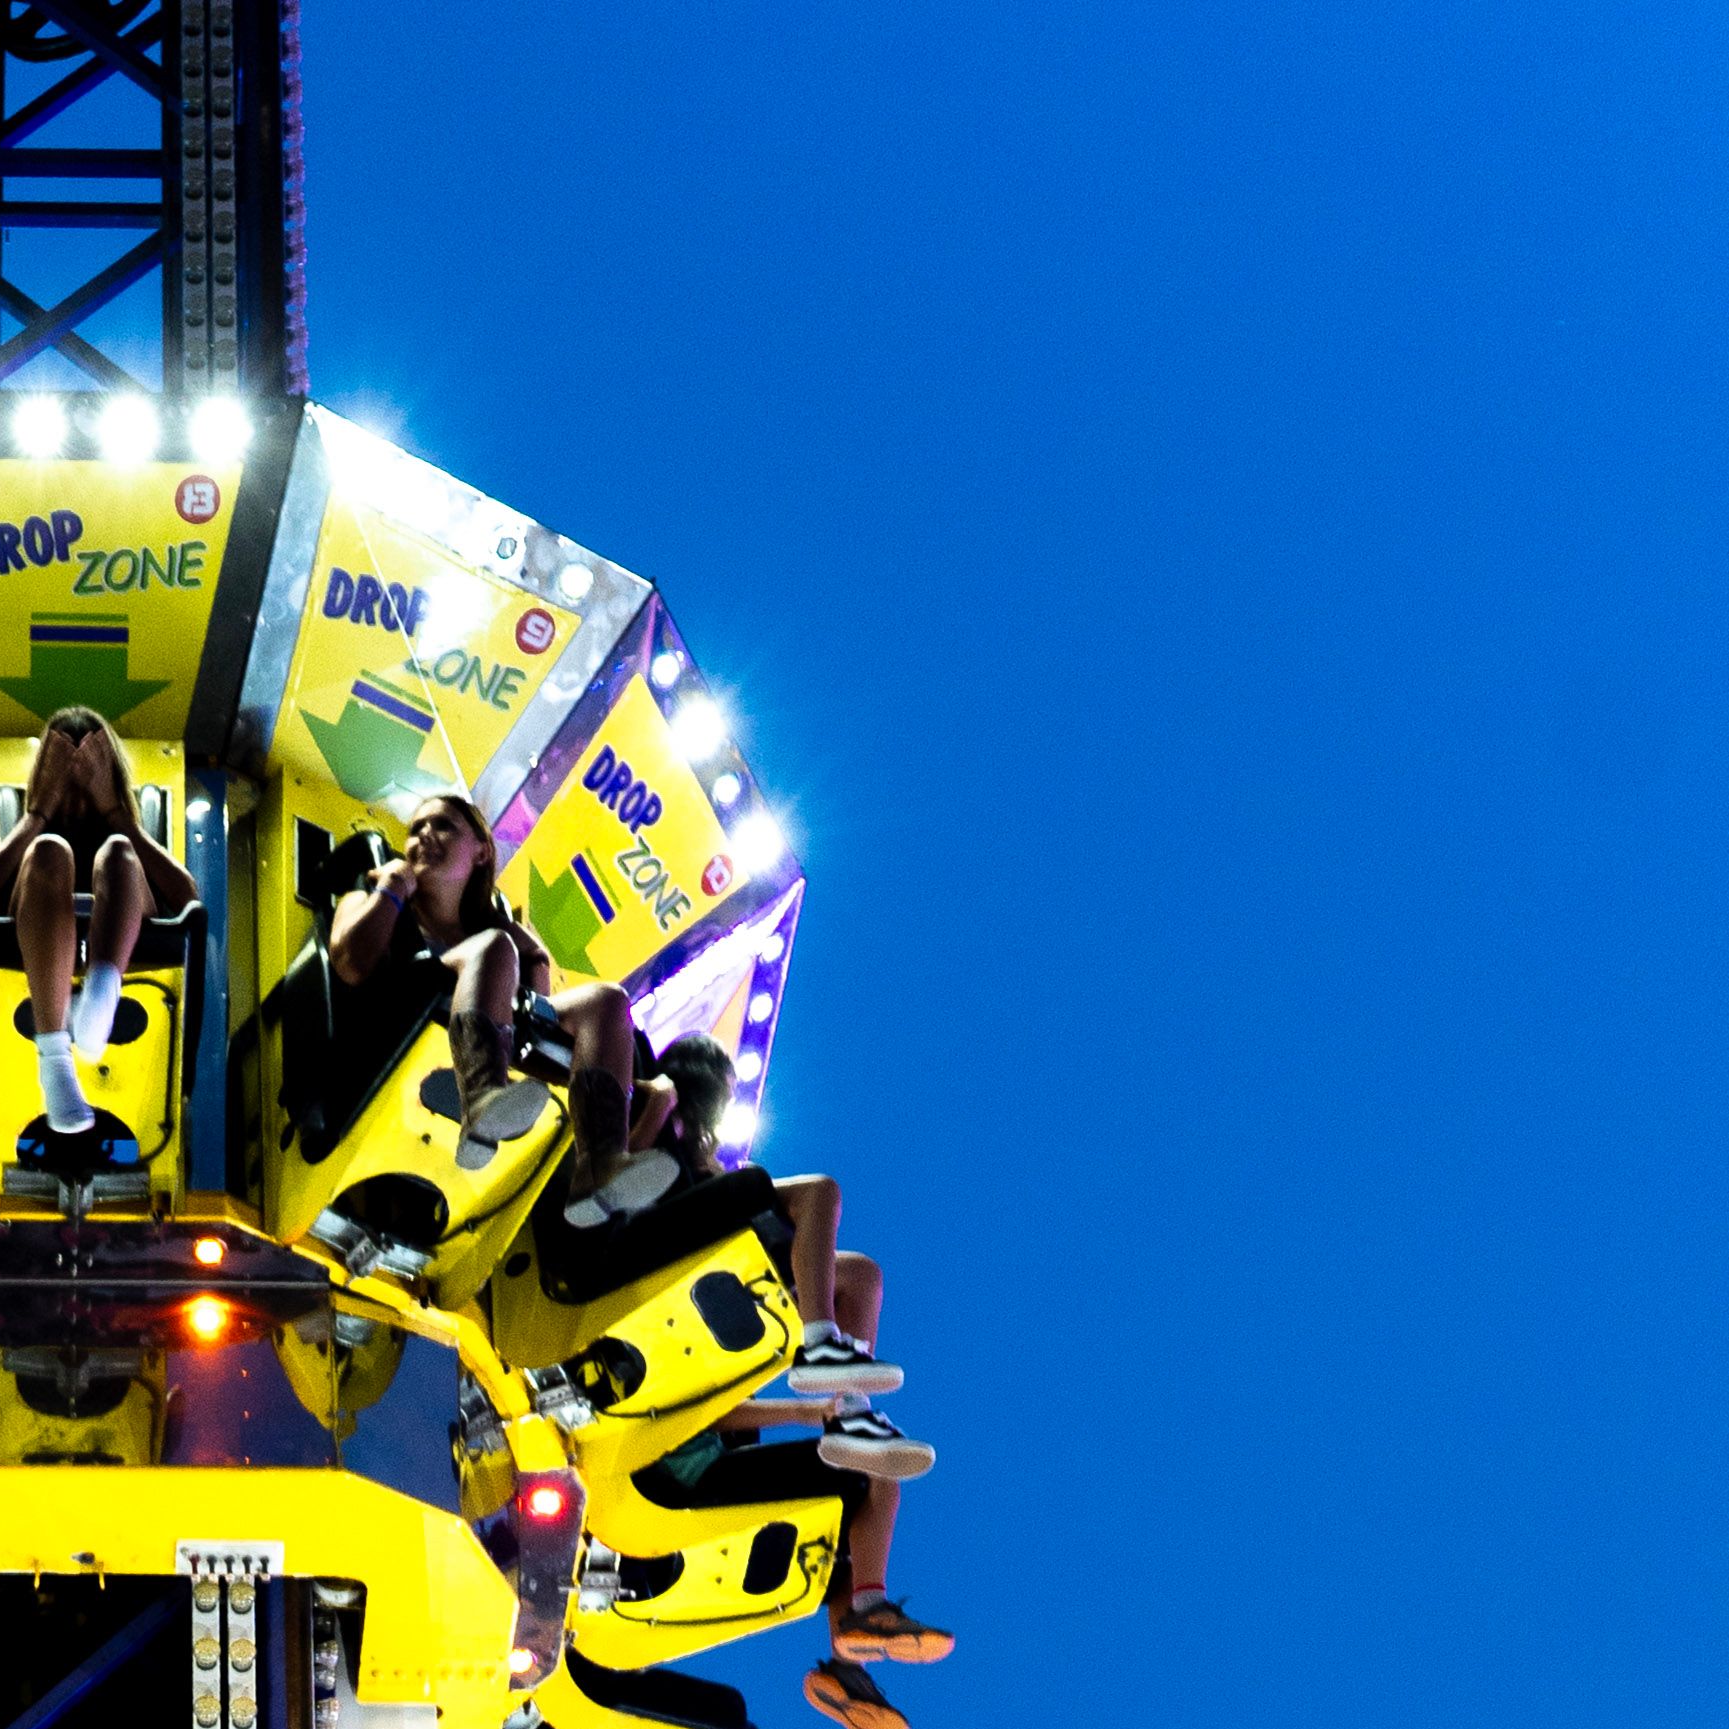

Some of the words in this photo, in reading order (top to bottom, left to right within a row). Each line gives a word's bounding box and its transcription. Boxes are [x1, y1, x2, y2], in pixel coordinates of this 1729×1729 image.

[71, 541, 208, 597] ZONE
[583, 744, 662, 834] DROP
[617, 836, 692, 932] ZONE
